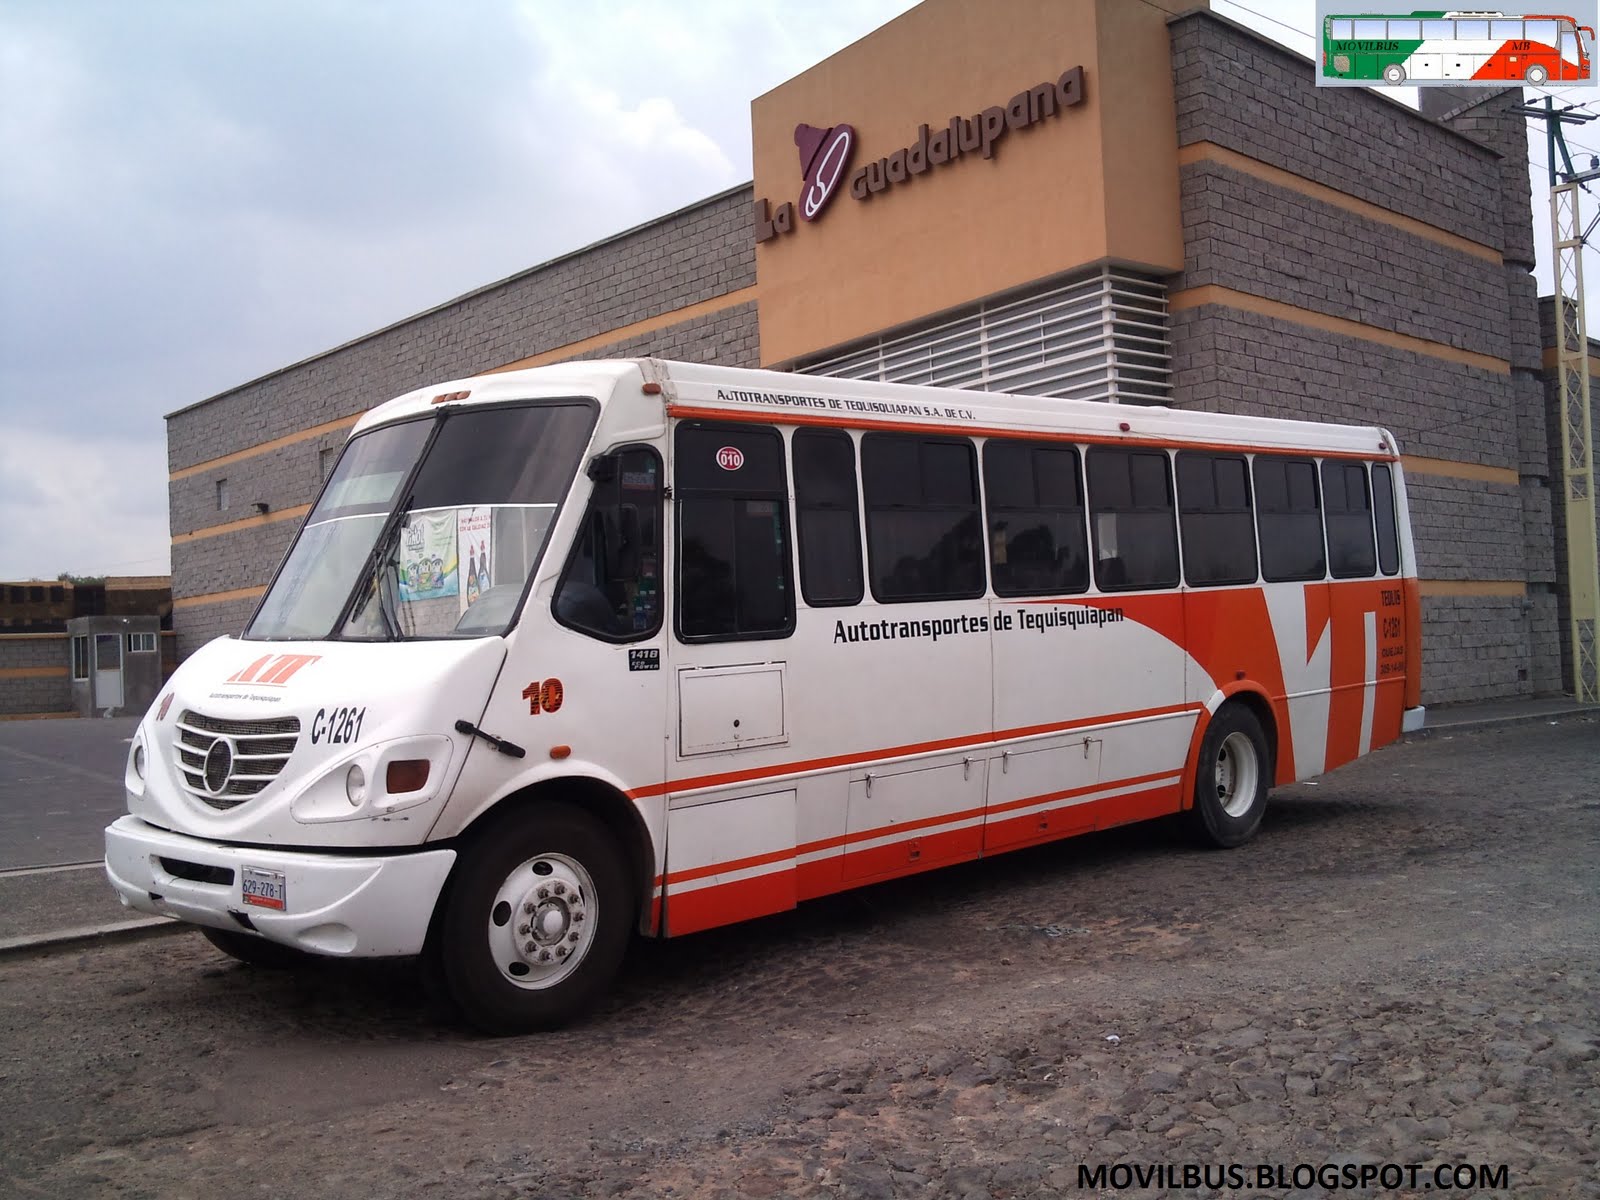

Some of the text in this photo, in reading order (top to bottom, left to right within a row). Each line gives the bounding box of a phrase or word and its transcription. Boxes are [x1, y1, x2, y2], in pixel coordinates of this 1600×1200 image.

[753, 198, 792, 244] La
[828, 398, 843, 410] DE
[844, 400, 922, 415] TEQUISQUIAPAN
[923, 406, 943, 417] S.A.
[944, 408, 957, 418] DE
[958, 409, 976, 420] C.V.
[720, 454, 740, 466] 010
[833, 606, 1124, 644] Autotransportes de Tequisquiapan
[630, 650, 658, 659] 1418
[522, 678, 563, 715] 10
[311, 707, 366, 745] C-1261
[243, 880, 282, 899] 629-278-T
